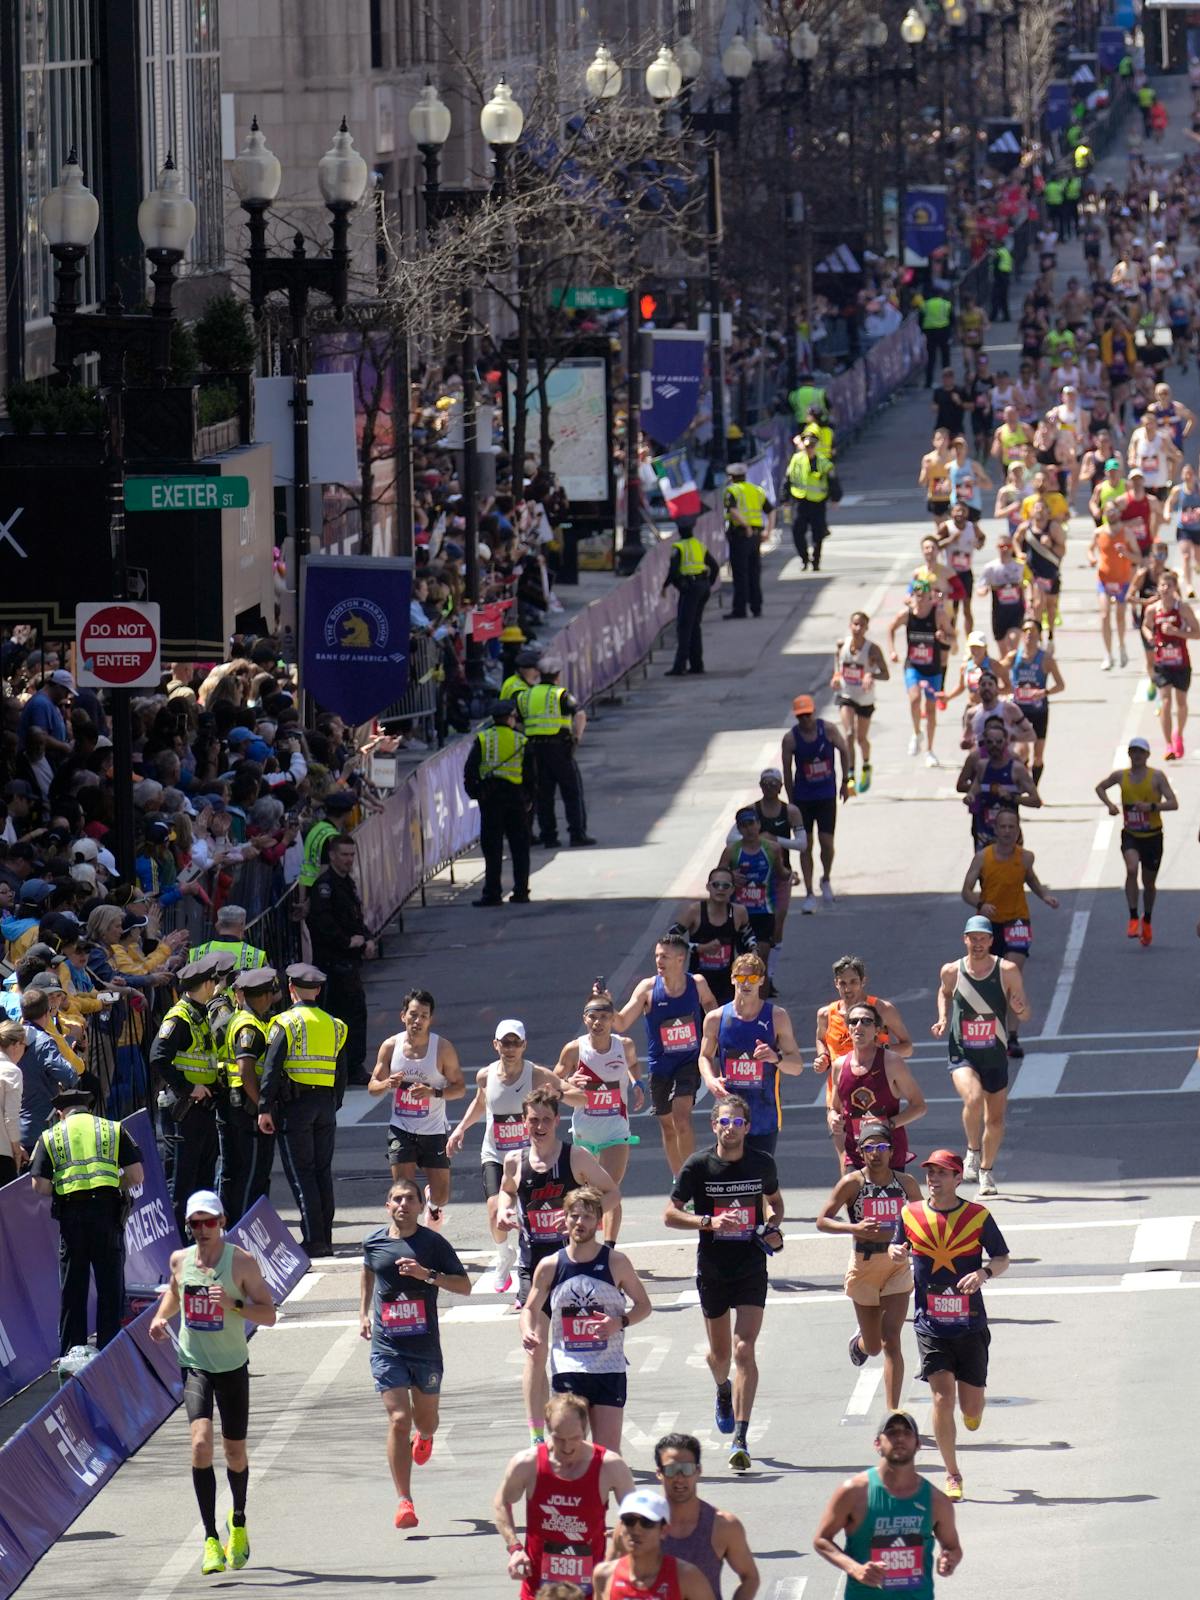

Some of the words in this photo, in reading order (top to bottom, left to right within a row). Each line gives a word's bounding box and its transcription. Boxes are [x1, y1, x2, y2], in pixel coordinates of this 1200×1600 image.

[152, 484, 218, 508] EXETER
[222, 493, 234, 507] ST
[330, 600, 359, 623] BOSTON
[362, 601, 387, 642] MARATHON
[90, 623, 111, 636] DO
[117, 623, 146, 636] NOT
[96, 655, 141, 667] ENTER
[316, 653, 336, 661] BANK
[340, 653, 350, 661] OF
[352, 654, 388, 662] AMERICA
[668, 1026, 691, 1040] 3759
[968, 1024, 991, 1036] 5177
[732, 1062, 756, 1076] 1434
[593, 1092, 611, 1105] 775
[499, 1124, 524, 1139] 5309
[706, 1185, 724, 1193] ciele
[872, 1200, 897, 1216] 1019
[124, 1197, 170, 1256] ATHLETICS
[536, 1211, 560, 1228] 137
[390, 1303, 418, 1319] 4494
[547, 1496, 581, 1506] JOLLY
[875, 1515, 925, 1530] O'LEARY
[551, 1557, 582, 1576] 5391
